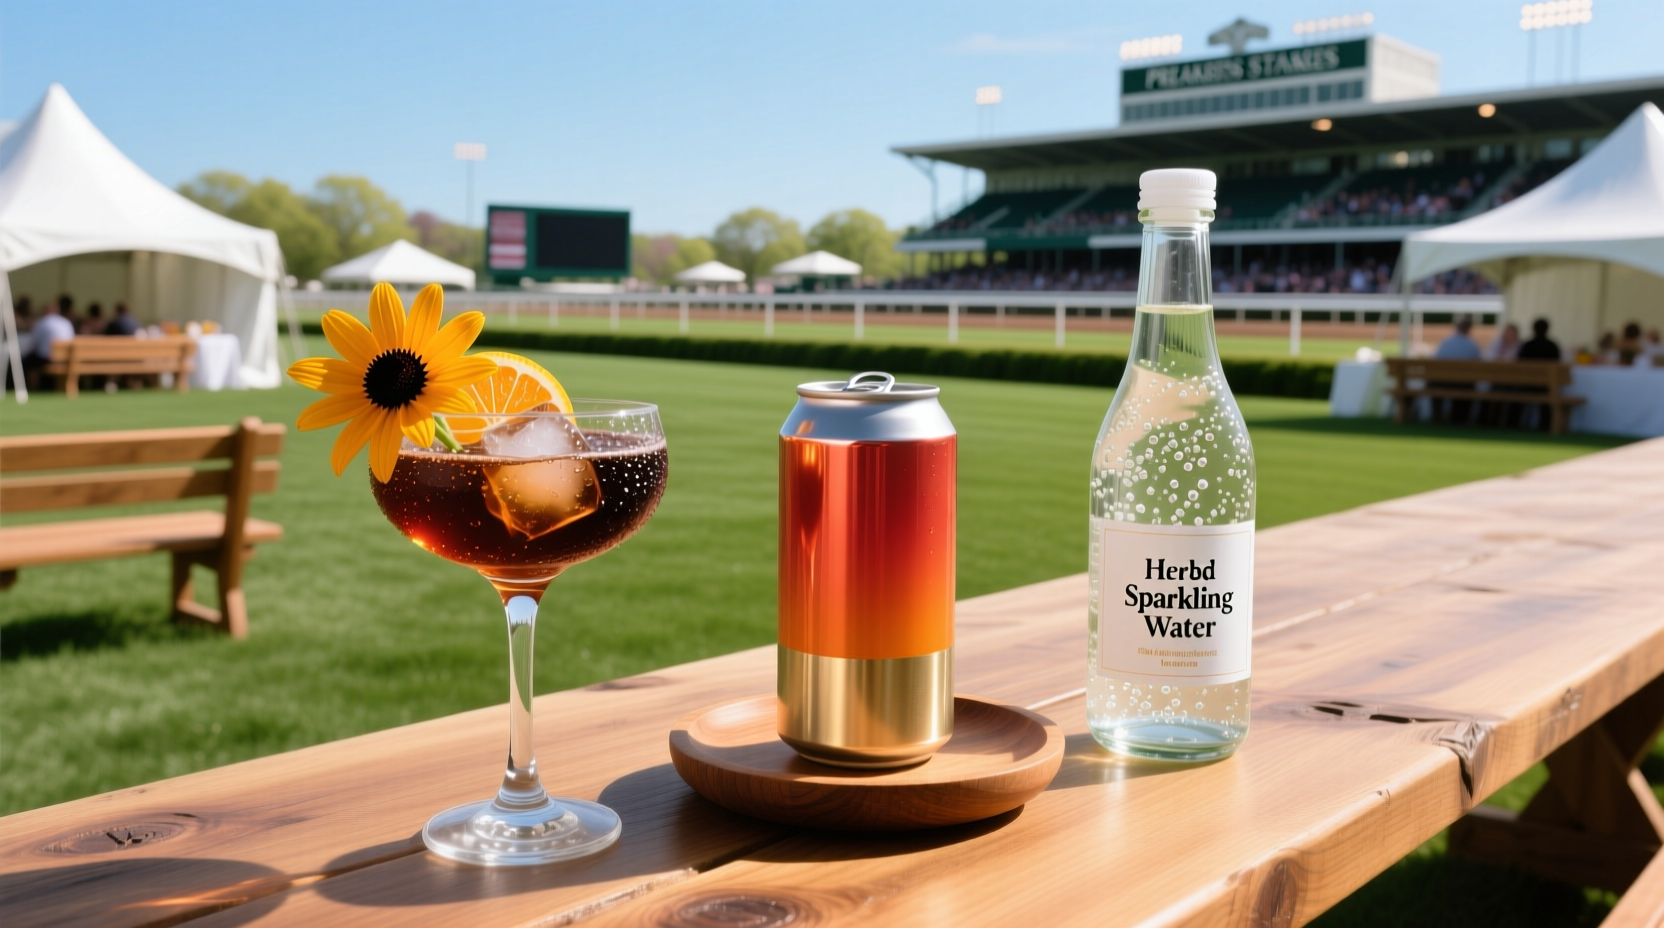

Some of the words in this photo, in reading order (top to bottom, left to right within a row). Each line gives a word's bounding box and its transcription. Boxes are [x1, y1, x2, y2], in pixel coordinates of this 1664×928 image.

[1145, 558, 1216, 581] Herbd
[1125, 584, 1234, 615] Sparkling
[1144, 615, 1217, 638] Water
